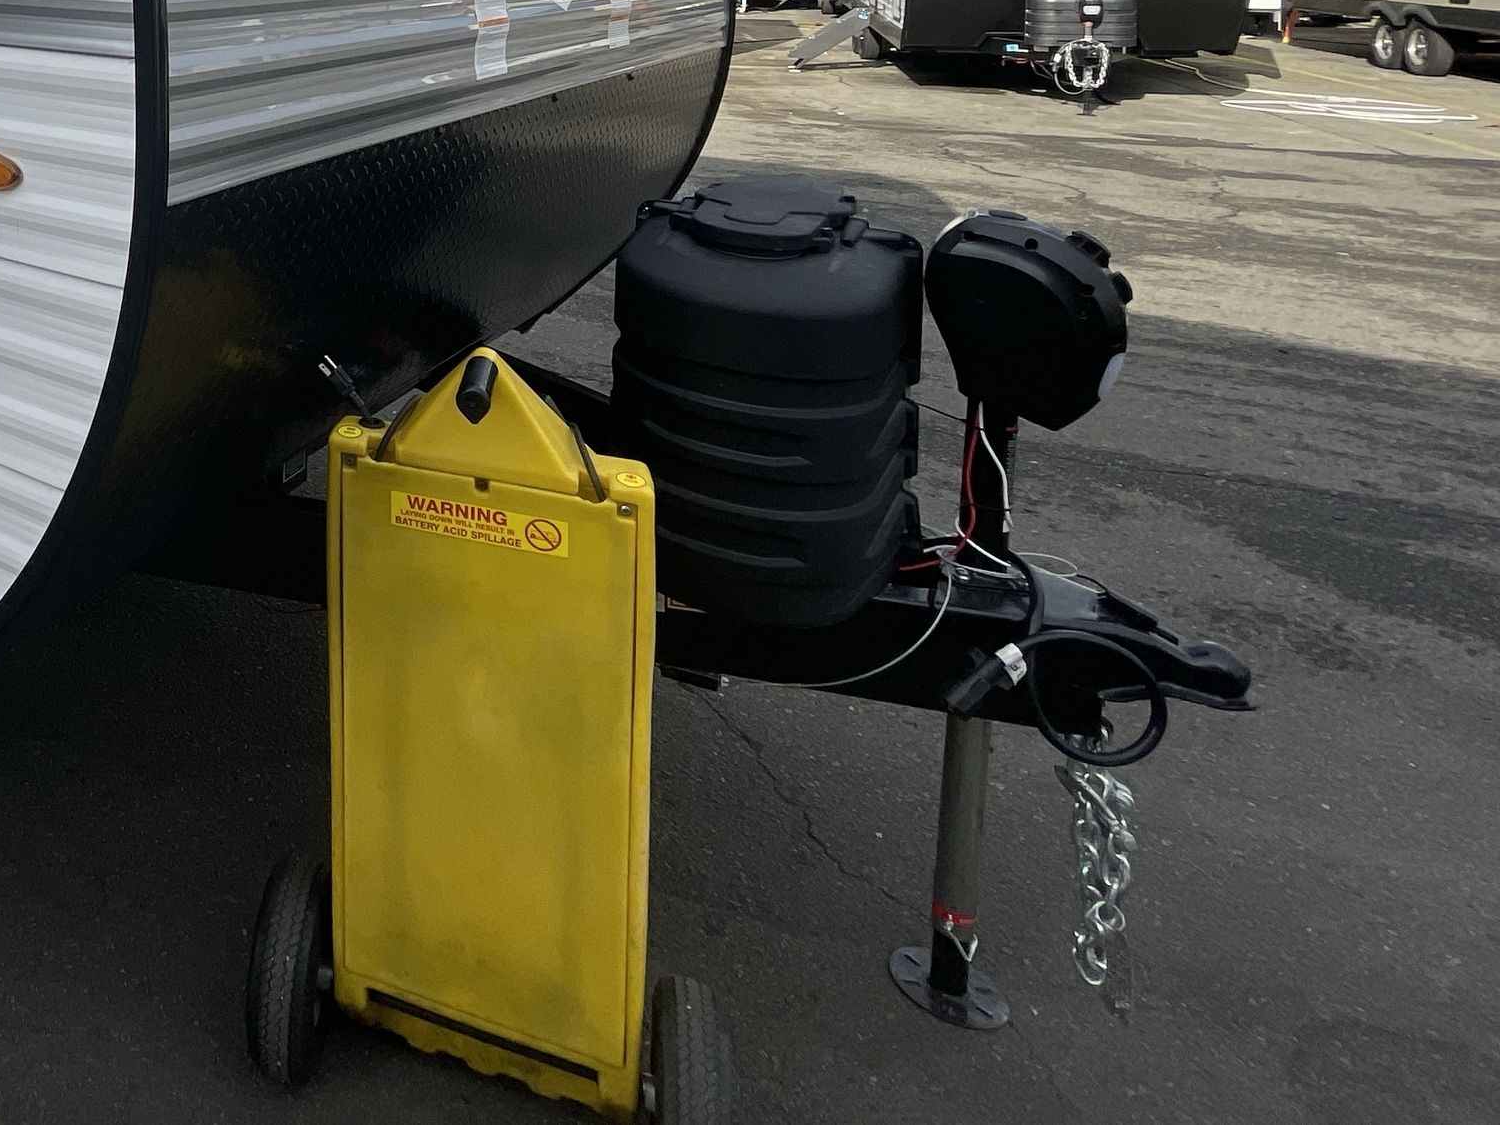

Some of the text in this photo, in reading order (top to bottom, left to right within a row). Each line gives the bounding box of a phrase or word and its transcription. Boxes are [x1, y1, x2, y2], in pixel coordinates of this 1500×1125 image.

[400, 508, 515, 536] LAYING DOWN WILL RESULT IN
[406, 495, 507, 527] WARNING
[395, 515, 522, 548] BATTERY ACID SPILLAGE
